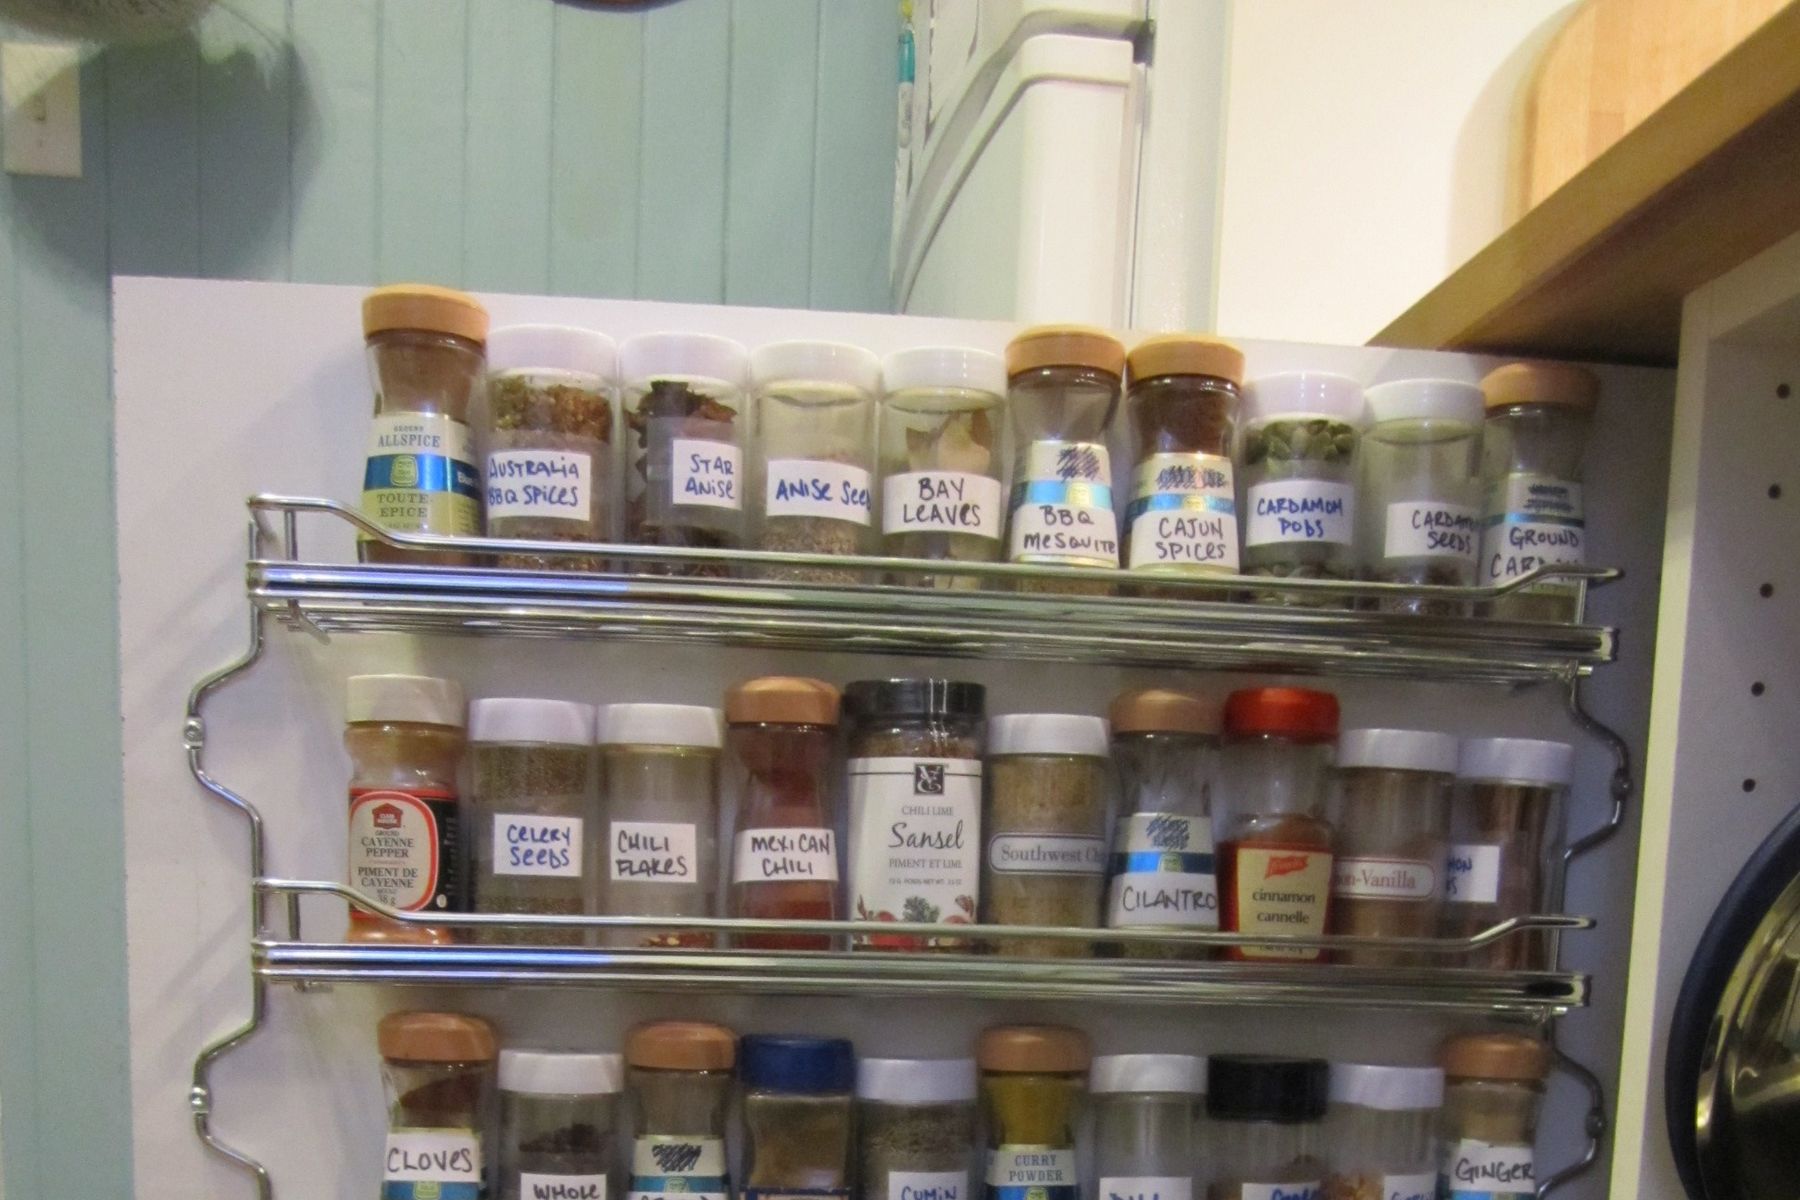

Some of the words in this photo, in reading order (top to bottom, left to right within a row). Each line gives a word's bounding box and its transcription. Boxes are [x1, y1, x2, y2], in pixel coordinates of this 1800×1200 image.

[377, 434, 441, 448] ALLSPICE
[689, 453, 734, 475] STAR
[523, 486, 579, 507] SPICES
[775, 477, 833, 501] ANISE
[917, 476, 965, 501] BAY
[902, 503, 982, 527] LEAVES
[1040, 504, 1095, 527] BBQ
[1158, 517, 1224, 541] CAJUN
[1509, 527, 1581, 549] GROUND
[1155, 541, 1226, 561] SPICES
[901, 805, 931, 817] CHILI
[361, 836, 415, 848] CAYENNE
[507, 823, 571, 846] CELERY
[618, 830, 670, 853] CHILI
[887, 819, 965, 851] Sansel
[366, 847, 410, 858] PEPPER
[999, 845, 1082, 863] Southwest
[358, 866, 400, 878] PIMENT
[402, 867, 419, 878] DE
[761, 857, 813, 877] CHILI
[888, 858, 927, 869] PIMENT
[928, 859, 942, 869] ET
[361, 877, 415, 889] CAYENNE
[1123, 885, 1217, 912] CILANTRO
[1252, 888, 1316, 905] cinnamon
[1257, 910, 1311, 925] cannelle
[386, 1147, 473, 1173] CLOVES
[1013, 1154, 1058, 1168] CURRY
[1008, 1170, 1064, 1183] POWDER
[1454, 1157, 1535, 1184] GINGER
[532, 1183, 601, 1200] WHOLE
